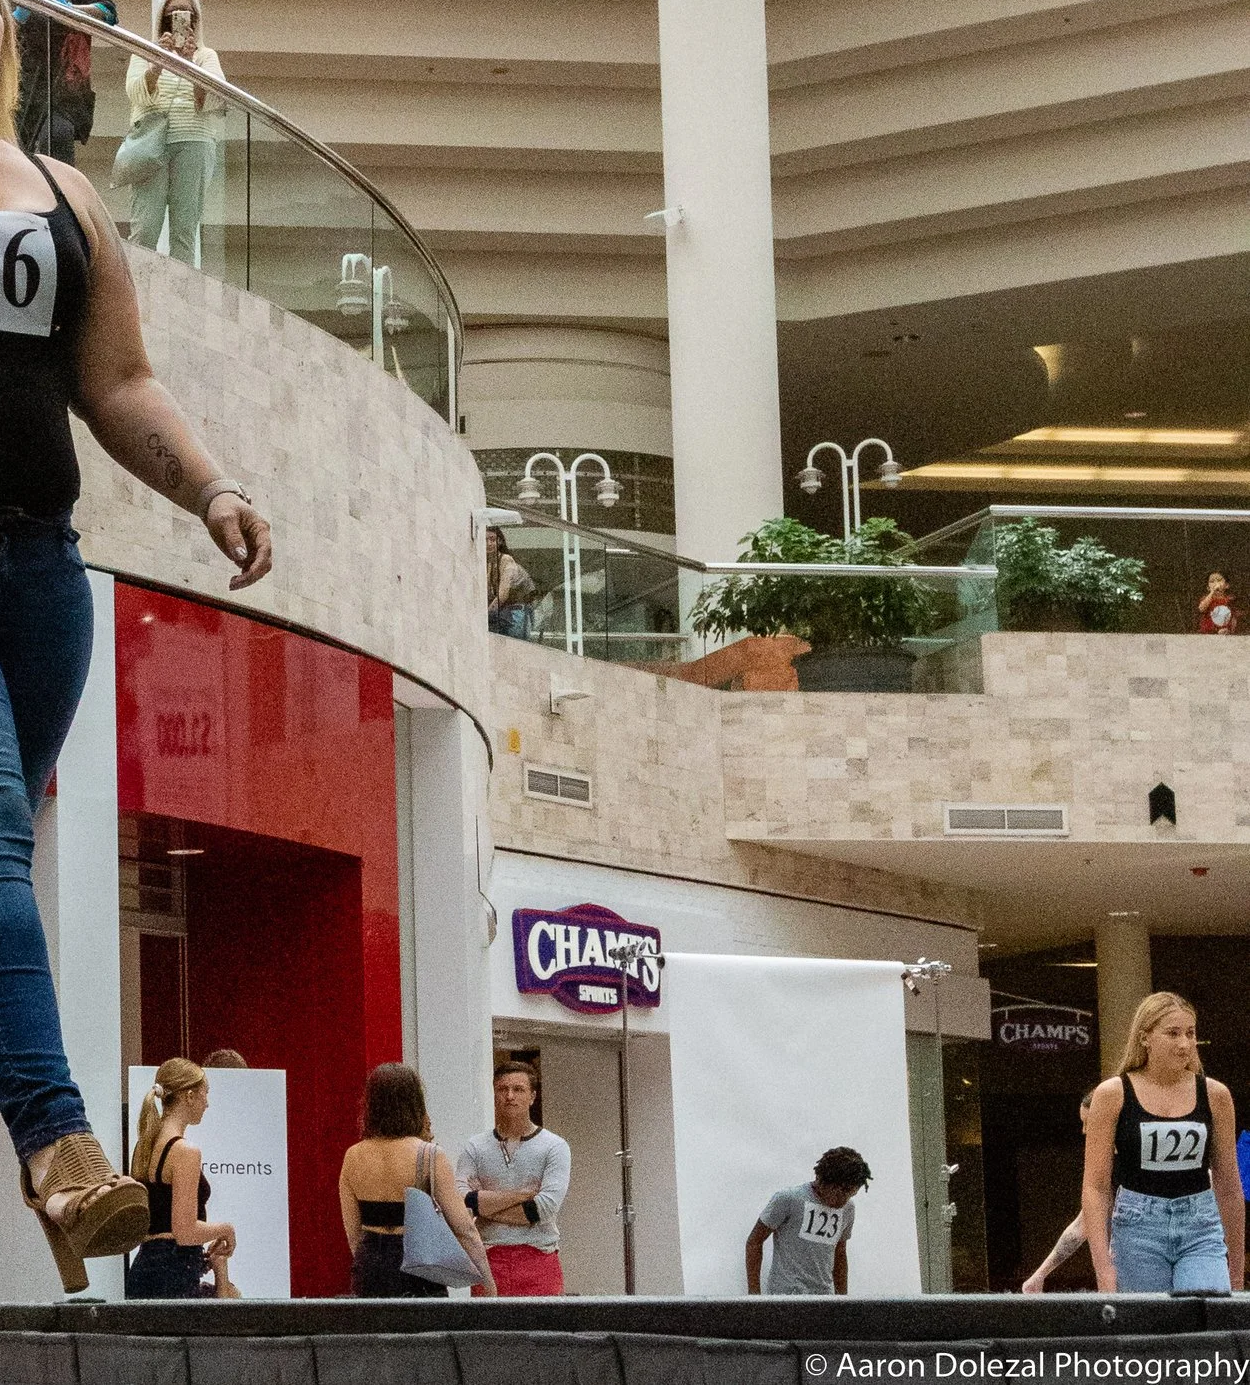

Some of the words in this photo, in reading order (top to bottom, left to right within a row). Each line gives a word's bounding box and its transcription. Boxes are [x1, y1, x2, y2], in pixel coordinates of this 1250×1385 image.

[1000, 1023, 1090, 1045] CHAMPS
[1147, 1129, 1200, 1163] 122
[804, 1209, 839, 1239] 123
